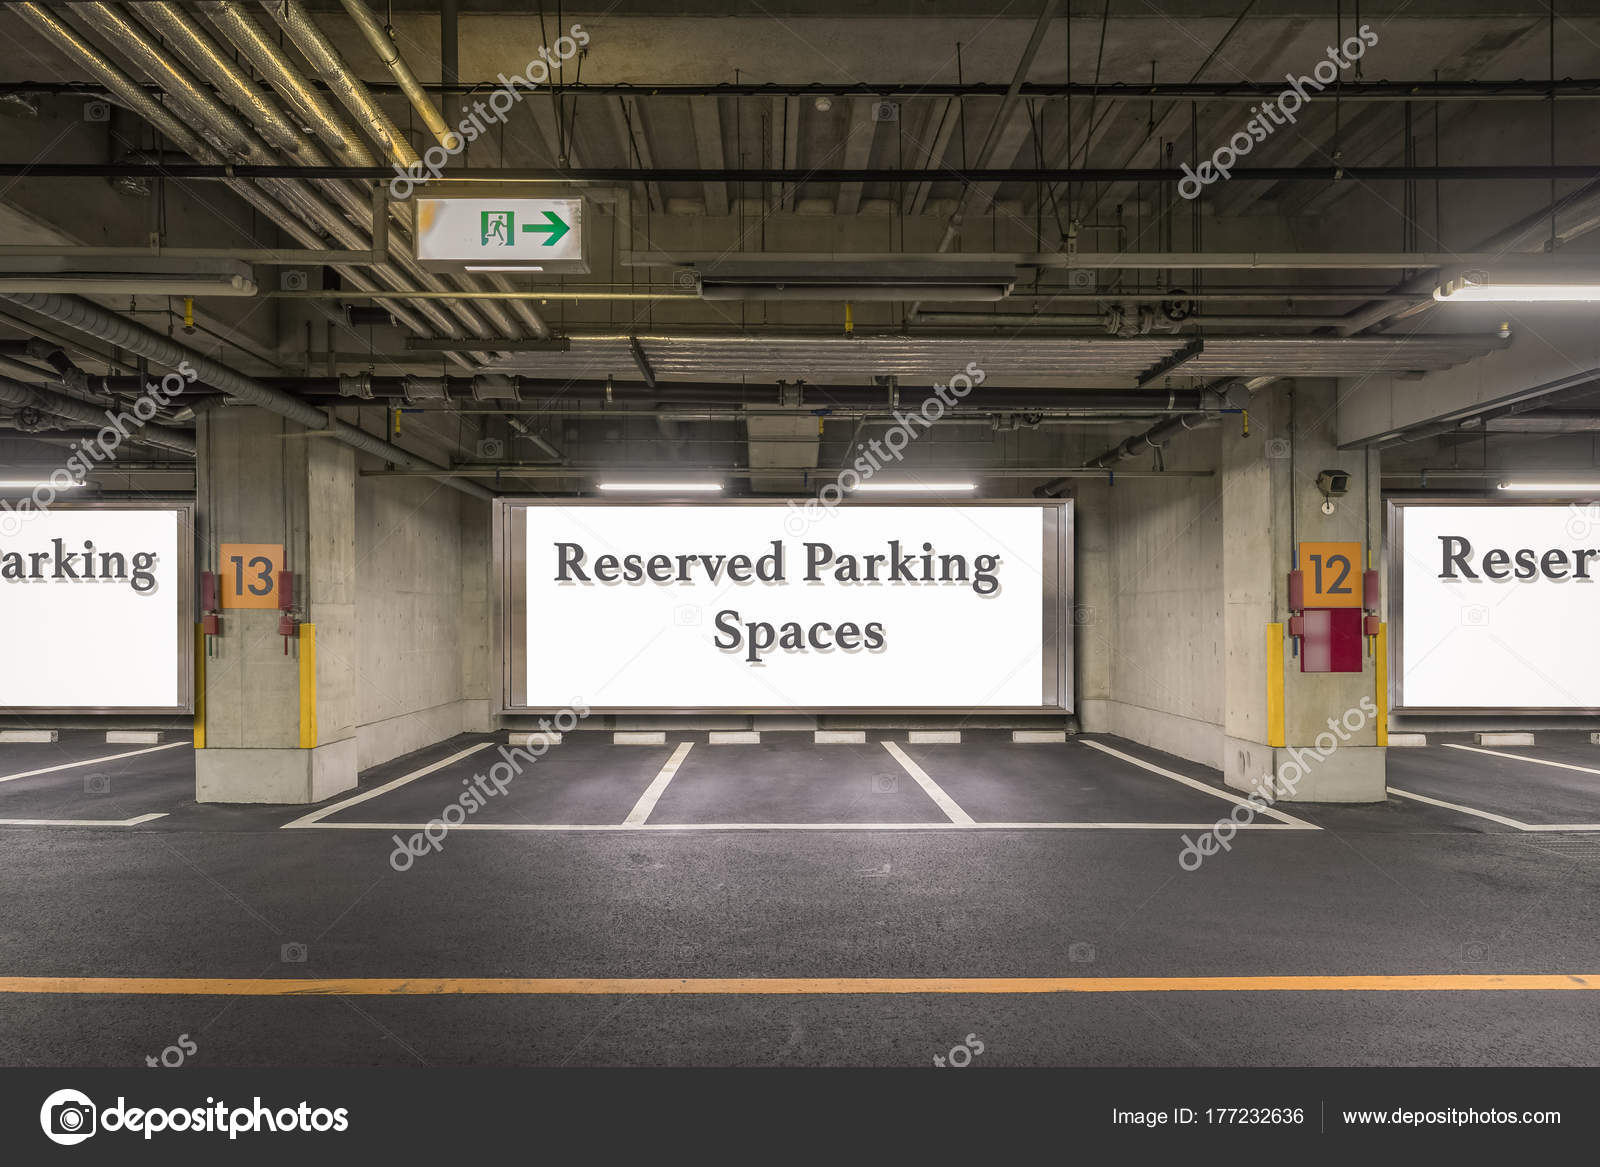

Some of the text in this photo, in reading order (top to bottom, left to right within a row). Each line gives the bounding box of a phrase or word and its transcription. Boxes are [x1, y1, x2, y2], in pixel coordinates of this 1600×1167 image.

[230, 555, 274, 596] 13
[554, 540, 1002, 595] Reserved Parking
[1309, 554, 1353, 595] 12
[1437, 535, 1600, 580] Reser
[714, 609, 885, 663] Spaces
